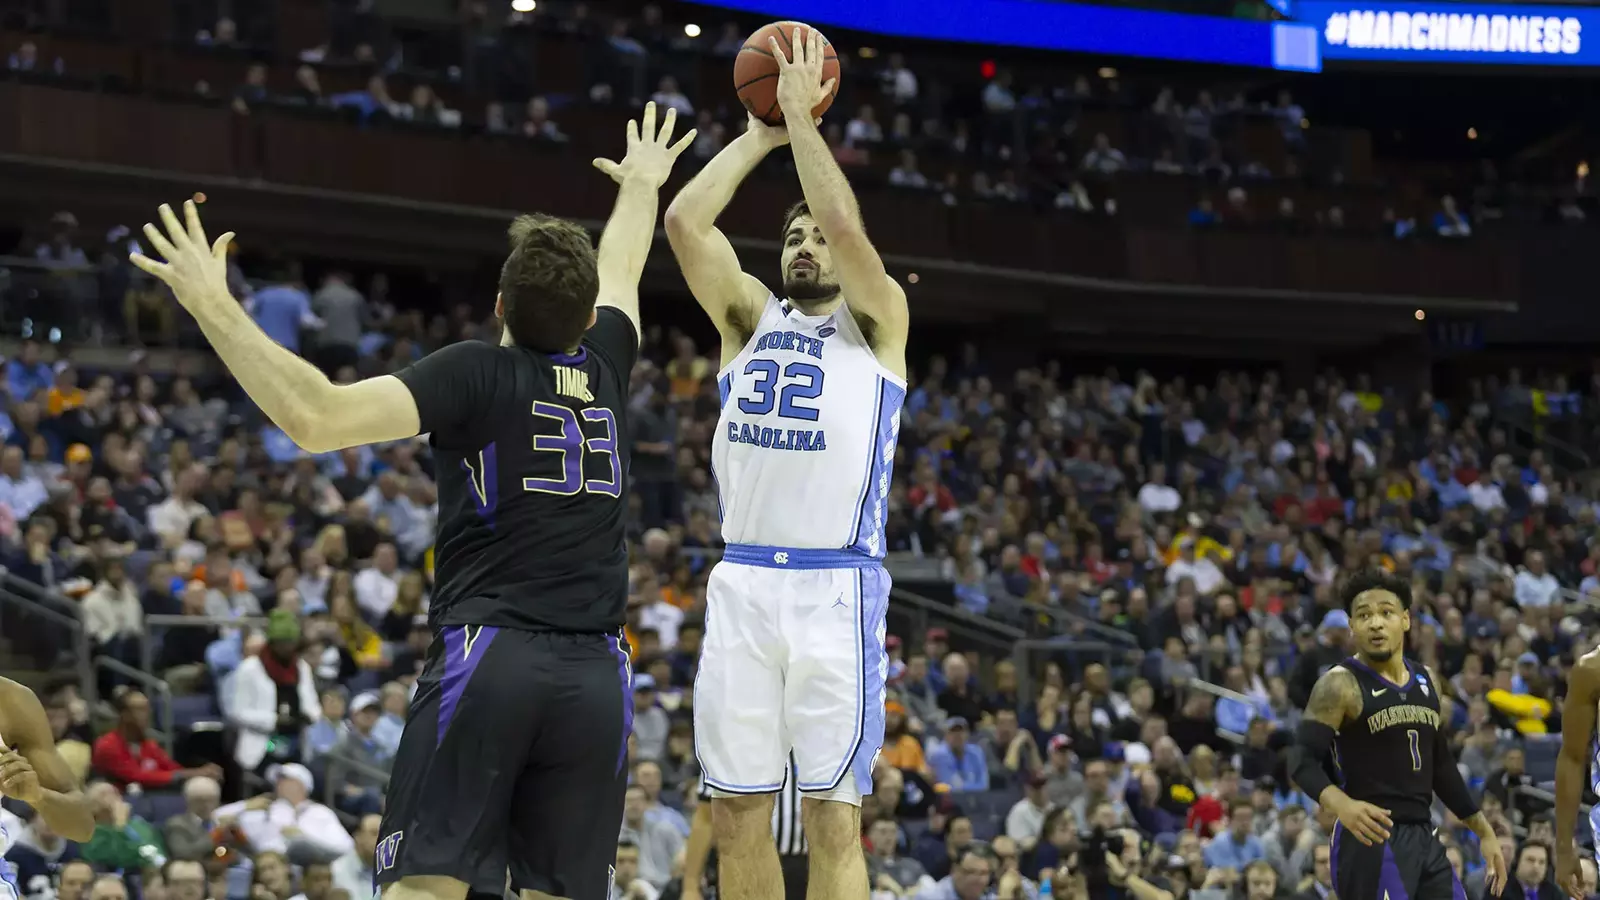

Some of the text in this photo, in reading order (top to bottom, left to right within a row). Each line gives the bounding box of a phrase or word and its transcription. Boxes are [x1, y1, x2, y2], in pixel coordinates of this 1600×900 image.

[1325, 10, 1581, 53] #MARCHMADNESS
[753, 331, 824, 359] NORTH
[738, 359, 825, 421] 32
[523, 400, 622, 498] 33
[728, 421, 827, 451] CAROLINA
[1407, 729, 1421, 771] 1
